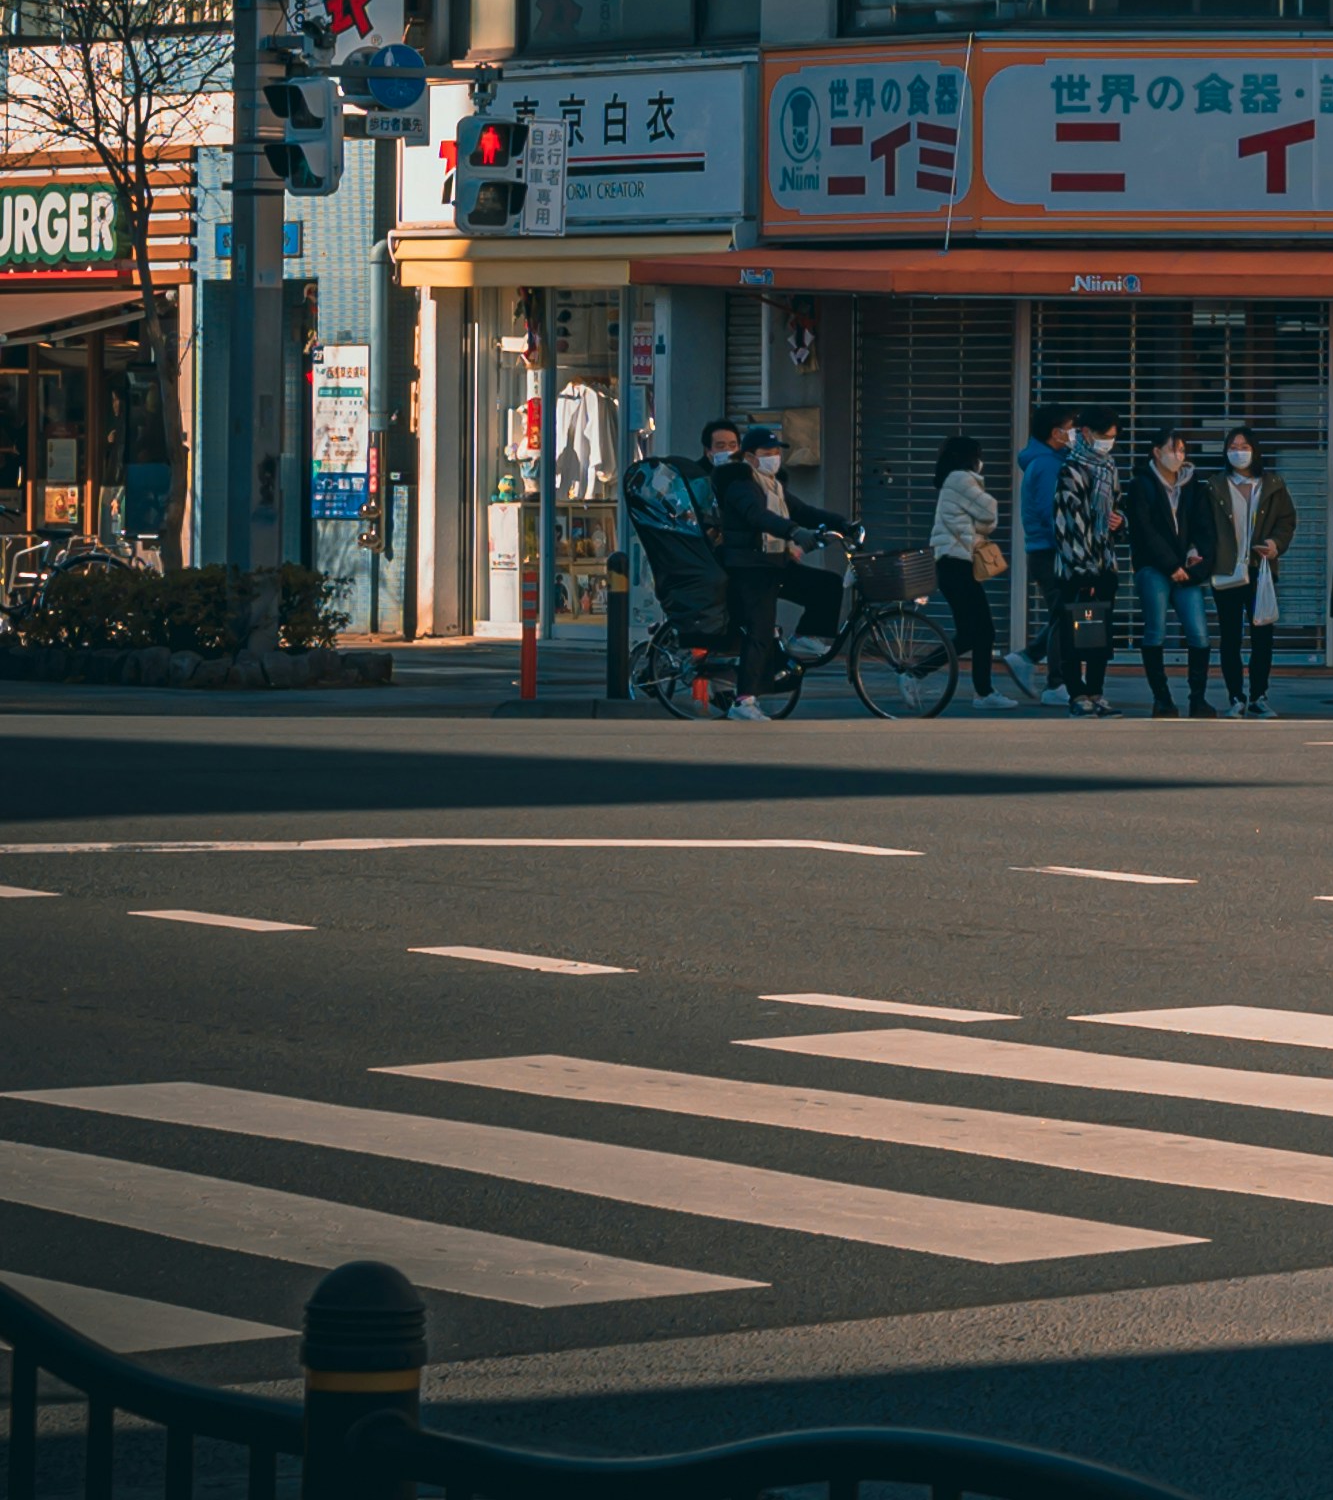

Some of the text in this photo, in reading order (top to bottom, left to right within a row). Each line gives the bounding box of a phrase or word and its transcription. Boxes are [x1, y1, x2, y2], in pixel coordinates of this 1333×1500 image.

[828, 73, 959, 120] 世界の食器
[827, 121, 958, 197] ニイミ
[597, 180, 645, 199] CREATOR
[779, 166, 820, 192] Niimi
[1071, 274, 1123, 293] Niimi
